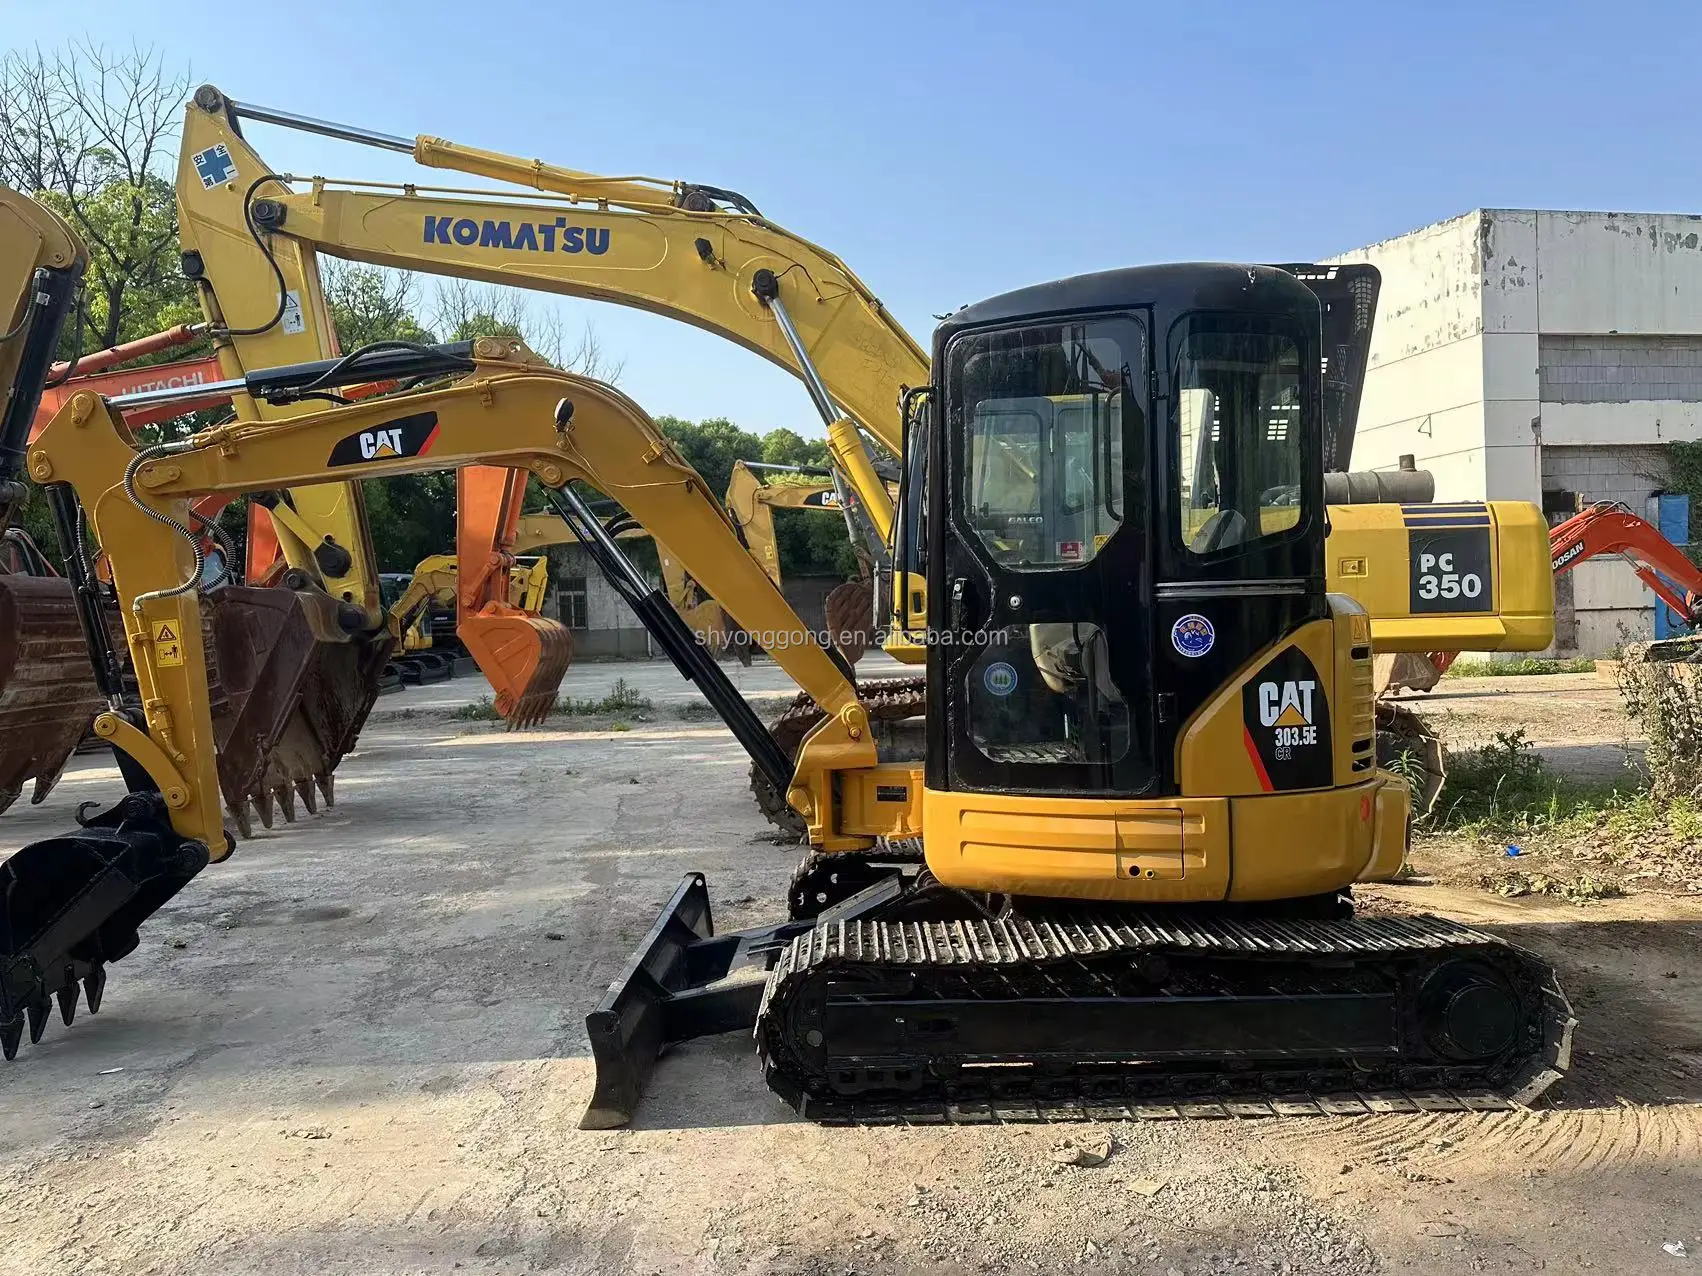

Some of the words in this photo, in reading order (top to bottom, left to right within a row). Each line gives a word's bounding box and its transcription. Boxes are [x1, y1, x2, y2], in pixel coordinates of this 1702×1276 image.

[423, 215, 611, 256] KOMATSU
[359, 428, 403, 460] CAT
[821, 491, 842, 506] CA
[1420, 553, 1454, 573] PC
[1418, 573, 1482, 600] 350
[1258, 680, 1316, 727] CAT
[1274, 725, 1317, 747] 303.5E
[1274, 746, 1292, 760] CR
